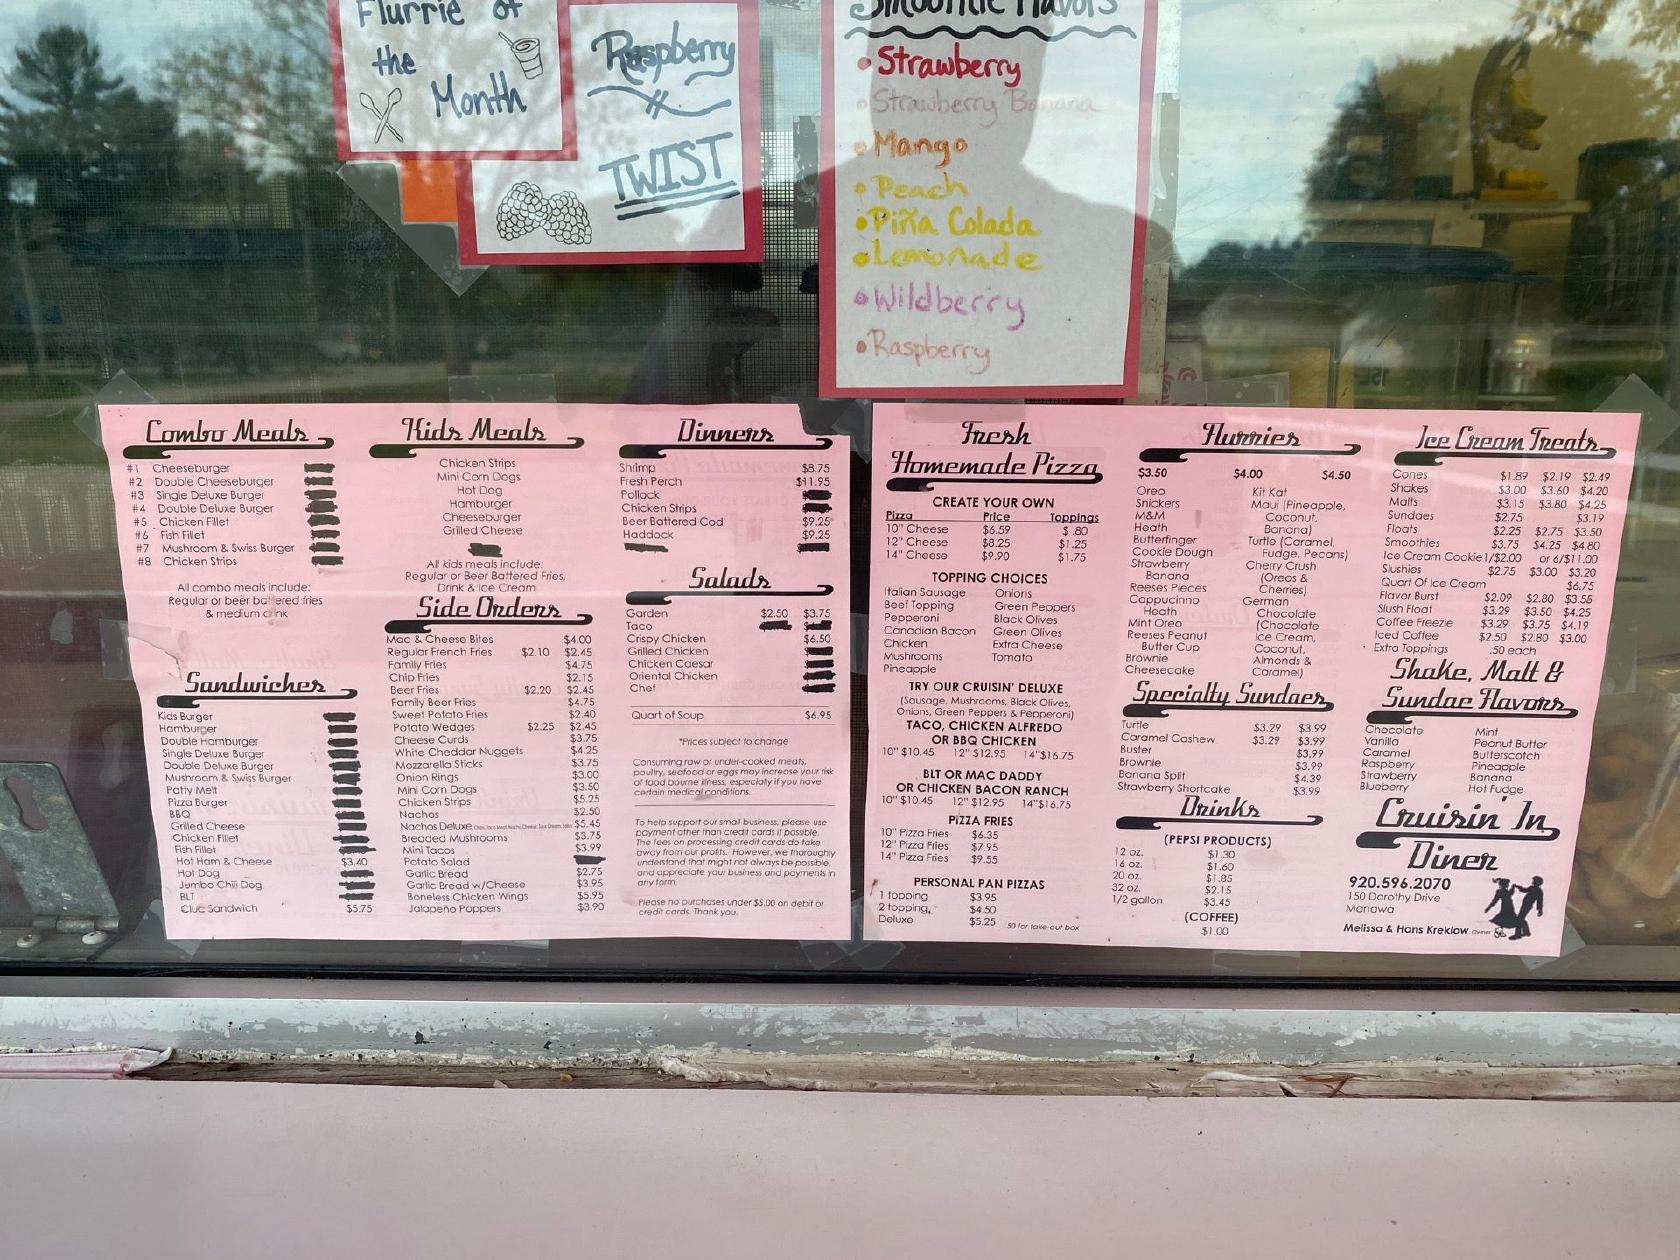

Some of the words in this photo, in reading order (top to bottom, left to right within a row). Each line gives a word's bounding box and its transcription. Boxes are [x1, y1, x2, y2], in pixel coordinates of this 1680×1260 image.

[492, 0, 524, 21] of
[372, 43, 418, 77] the
[590, 20, 736, 86] Raspberry
[876, 42, 1022, 88] Strawberry
[430, 70, 528, 119] Month
[872, 87, 998, 129] Strawberry
[873, 128, 969, 169] Mango
[599, 131, 734, 202] TWIST
[872, 171, 969, 200] Peach
[868, 206, 940, 237] Piña
[947, 204, 1041, 237] Colada
[874, 239, 1043, 271] Lemonade
[874, 281, 1026, 331] Wildberry
[866, 327, 991, 376] Raspberry
[145, 419, 229, 444] Combo
[231, 418, 310, 443] Meals
[401, 417, 464, 442] Kids
[467, 417, 547, 442] Meals
[677, 418, 775, 443] Dinners
[961, 420, 1032, 445] Fresh
[1200, 422, 1302, 447] Flurries
[1414, 424, 1452, 450] Ice
[1454, 425, 1525, 451] Cream
[1528, 426, 1600, 452] Treats
[439, 457, 486, 469] Chicken
[488, 457, 516, 470] Strips
[619, 462, 656, 475] Shrimp
[801, 463, 831, 475] $8.75
[891, 450, 1027, 475] Homemade
[1031, 451, 1099, 476] Pizza
[1137, 466, 1168, 480] $3.50
[1233, 468, 1264, 480] $4.00
[1321, 469, 1352, 481] $4.50
[128, 476, 144, 487] #2
[154, 476, 194, 487] Double
[196, 476, 275, 488] Cheeseburger
[619, 476, 648, 487] Fresh
[650, 476, 683, 487] Perch
[795, 476, 831, 488] $11.95
[1389, 482, 1429, 494] Shakes
[1497, 484, 1527, 496] $3.00
[1540, 485, 1570, 497] $3.60
[1580, 485, 1609, 498] $4.20
[621, 502, 667, 514] Chicken
[669, 503, 697, 515] Strips
[932, 496, 980, 508] CREATE
[982, 496, 1019, 509] YOUR
[1021, 497, 1055, 509] OWN
[1135, 498, 1181, 509] Snickers
[133, 516, 148, 527] #5
[159, 516, 204, 527] Chicken
[206, 516, 229, 527] Fillet
[442, 512, 522, 524] Cheeseburger
[442, 525, 479, 536] Grilled
[480, 525, 523, 536] Cheese
[622, 529, 674, 540] Haddock
[801, 529, 831, 542] $9.25
[1133, 534, 1198, 547] Butterfinger
[1384, 536, 1440, 548] Smoothies
[1491, 538, 1520, 550] $3.75
[1532, 539, 1562, 551] $4.25
[1571, 540, 1601, 552] $4.80
[135, 543, 150, 553] #7
[162, 543, 218, 554] Mushroom
[220, 543, 229, 553] &
[231, 543, 258, 553] Swiss
[260, 543, 295, 555] Burger
[688, 566, 772, 589] Salads
[931, 571, 987, 584] TOPPING
[990, 572, 1048, 585] CHOICES
[415, 595, 473, 618] Side
[475, 595, 563, 619] Orders
[625, 608, 669, 619] Garden
[760, 608, 789, 620] $2.50
[803, 608, 831, 620] $3.75
[884, 612, 940, 625] Pepperoni
[626, 633, 660, 646] Crispy
[661, 633, 707, 644] Chicken
[803, 633, 831, 646] $6.50
[387, 647, 429, 659] Regular
[430, 646, 467, 657] French
[470, 647, 493, 657] Fries
[521, 647, 550, 659] $2.10
[564, 647, 593, 659] $2.45
[883, 651, 943, 662] Mushrooms
[1124, 664, 1195, 676] Cheesecake
[1389, 657, 1473, 683] Shake,
[1479, 659, 1540, 683] Malt
[1543, 660, 1565, 683] &
[184, 671, 327, 694] Sandwiches
[908, 681, 930, 692] TRY
[933, 681, 960, 692] OUR
[1018, 682, 1064, 694] DELUXE
[1132, 680, 1231, 707] Specialty
[1235, 681, 1326, 706] Sundaes
[1381, 685, 1474, 710] Sundae
[1477, 687, 1566, 712] Flavors
[631, 710, 662, 721] Quart
[664, 710, 676, 720] of
[677, 710, 705, 722] Soup
[804, 710, 832, 721] $6.95
[1472, 750, 1541, 761] Butterscotch
[395, 759, 452, 770] Mozzarella
[454, 759, 483, 769] Sticks
[570, 758, 599, 769] $3.75
[923, 768, 942, 780] BLT
[944, 769, 963, 780] OR
[964, 769, 996, 781] MAC
[999, 770, 1043, 782] DADDY
[1179, 794, 1261, 818] Drinks
[948, 814, 981, 826] PIZZA
[984, 815, 1014, 827] FRIES
[1510, 800, 1548, 831] In
[170, 821, 204, 831] Grilled
[205, 821, 246, 831] Cheese
[899, 828, 925, 838] Pizza
[927, 828, 949, 838] Fries
[971, 829, 999, 841] $6.35
[1164, 833, 1201, 847] (PEPSI
[1203, 835, 1272, 850] PRODUCTS)
[176, 856, 194, 866] Hot
[196, 856, 221, 866] Ham
[223, 857, 231, 866] &
[233, 856, 273, 866] Cheese
[340, 857, 368, 868] $3.40
[1407, 840, 1499, 871] Diner
[913, 876, 976, 889] PERSONAL
[978, 878, 1003, 889] PAN
[1006, 879, 1045, 890] PIZZAS
[1349, 875, 1452, 891] 920.596.2070
[407, 892, 451, 902] Boneless
[452, 892, 496, 902] Chicken
[497, 892, 529, 902] Wings
[577, 890, 605, 901] $5.95
[458, 904, 502, 915] Poppers
[577, 902, 605, 913] $3.90
[1184, 911, 1239, 925] (COFFEE)
[1200, 926, 1229, 937] $1.00
[1343, 923, 1384, 933] Melissa
[1385, 924, 1393, 934] &
[1396, 924, 1424, 935] Hans
